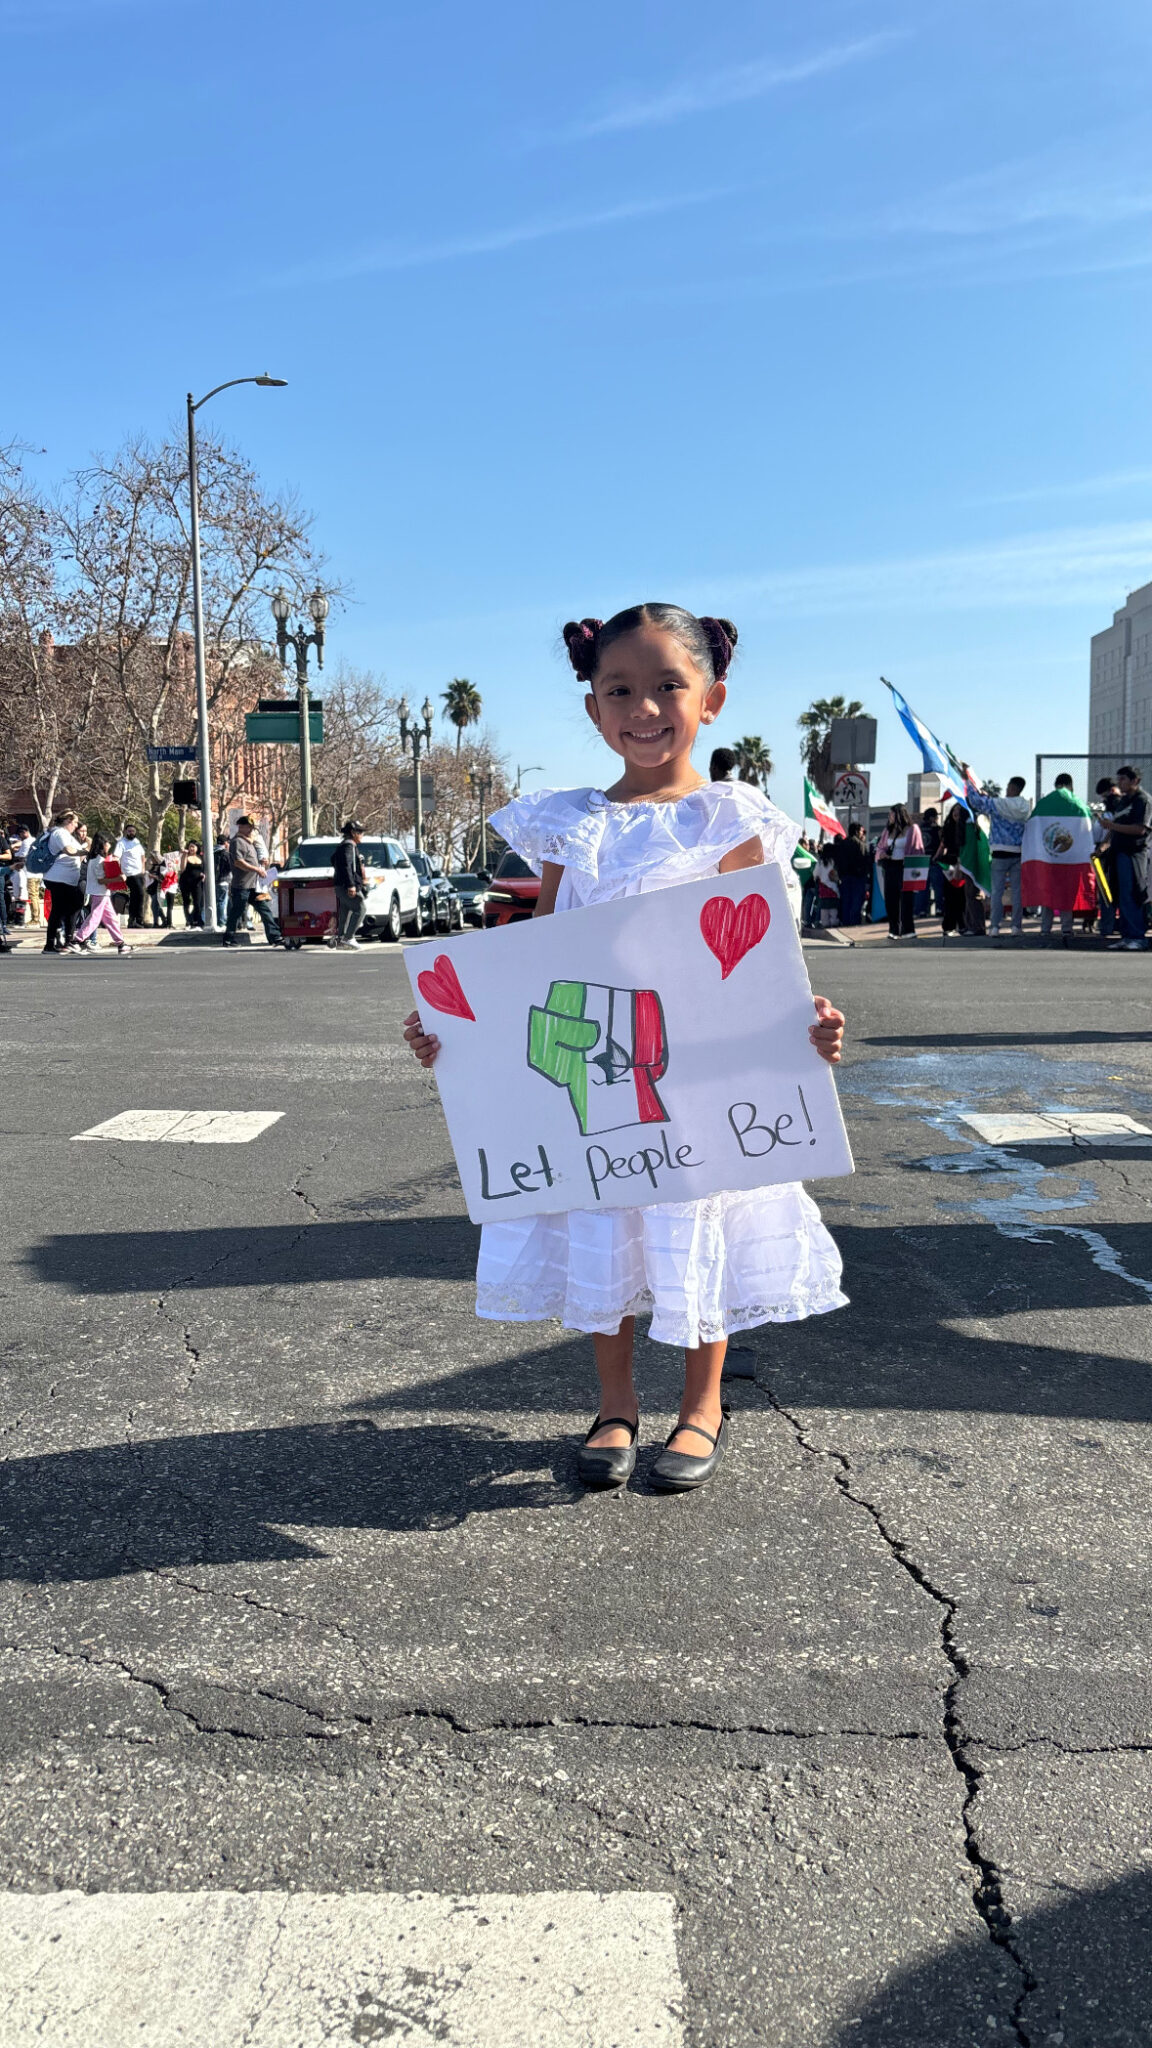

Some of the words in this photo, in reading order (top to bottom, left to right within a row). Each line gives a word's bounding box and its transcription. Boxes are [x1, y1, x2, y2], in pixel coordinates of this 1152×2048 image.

[169, 748, 185, 756] Main
[478, 1144, 554, 1200] Let
[728, 1085, 817, 1158] Be!
